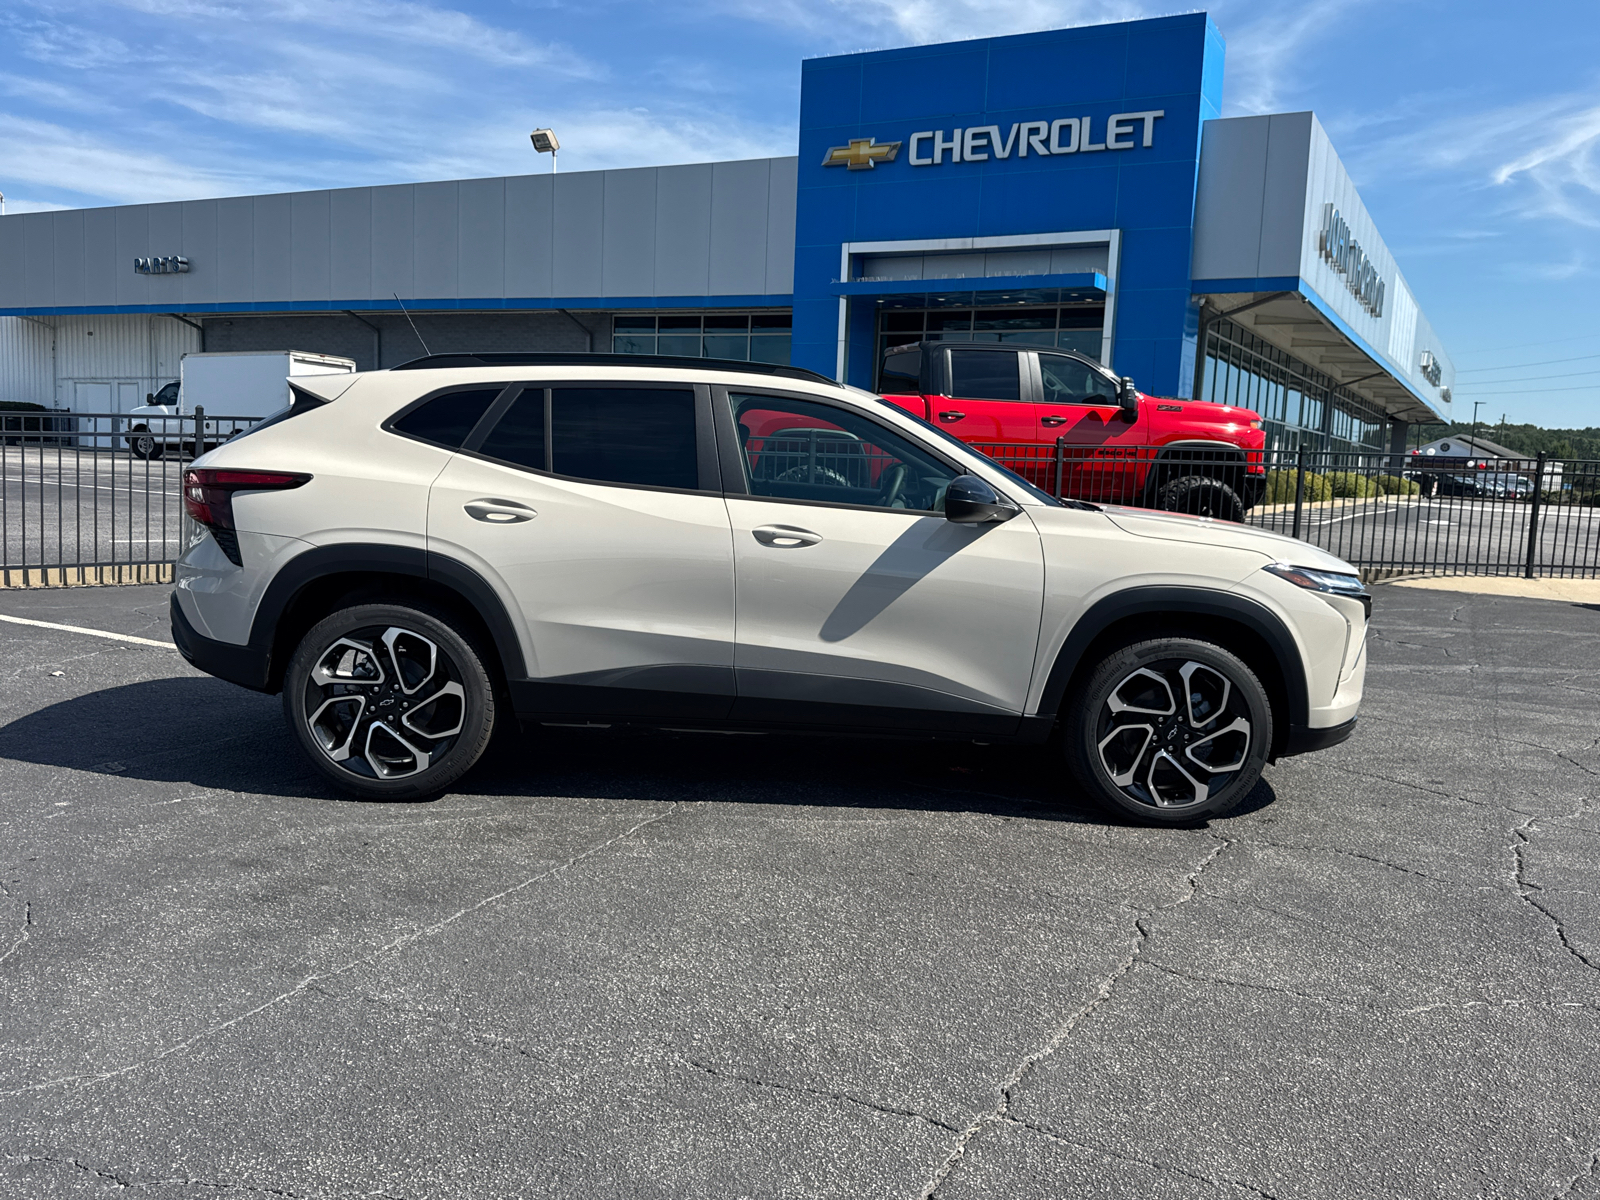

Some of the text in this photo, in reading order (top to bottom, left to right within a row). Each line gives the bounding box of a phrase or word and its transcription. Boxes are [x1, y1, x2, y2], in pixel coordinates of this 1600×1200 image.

[908, 109, 1165, 166] CHEVROLET
[134, 255, 186, 274] PARTS
[1091, 663, 1122, 700] Continental
[432, 749, 467, 781] Continental
[1226, 767, 1257, 804] Continental
